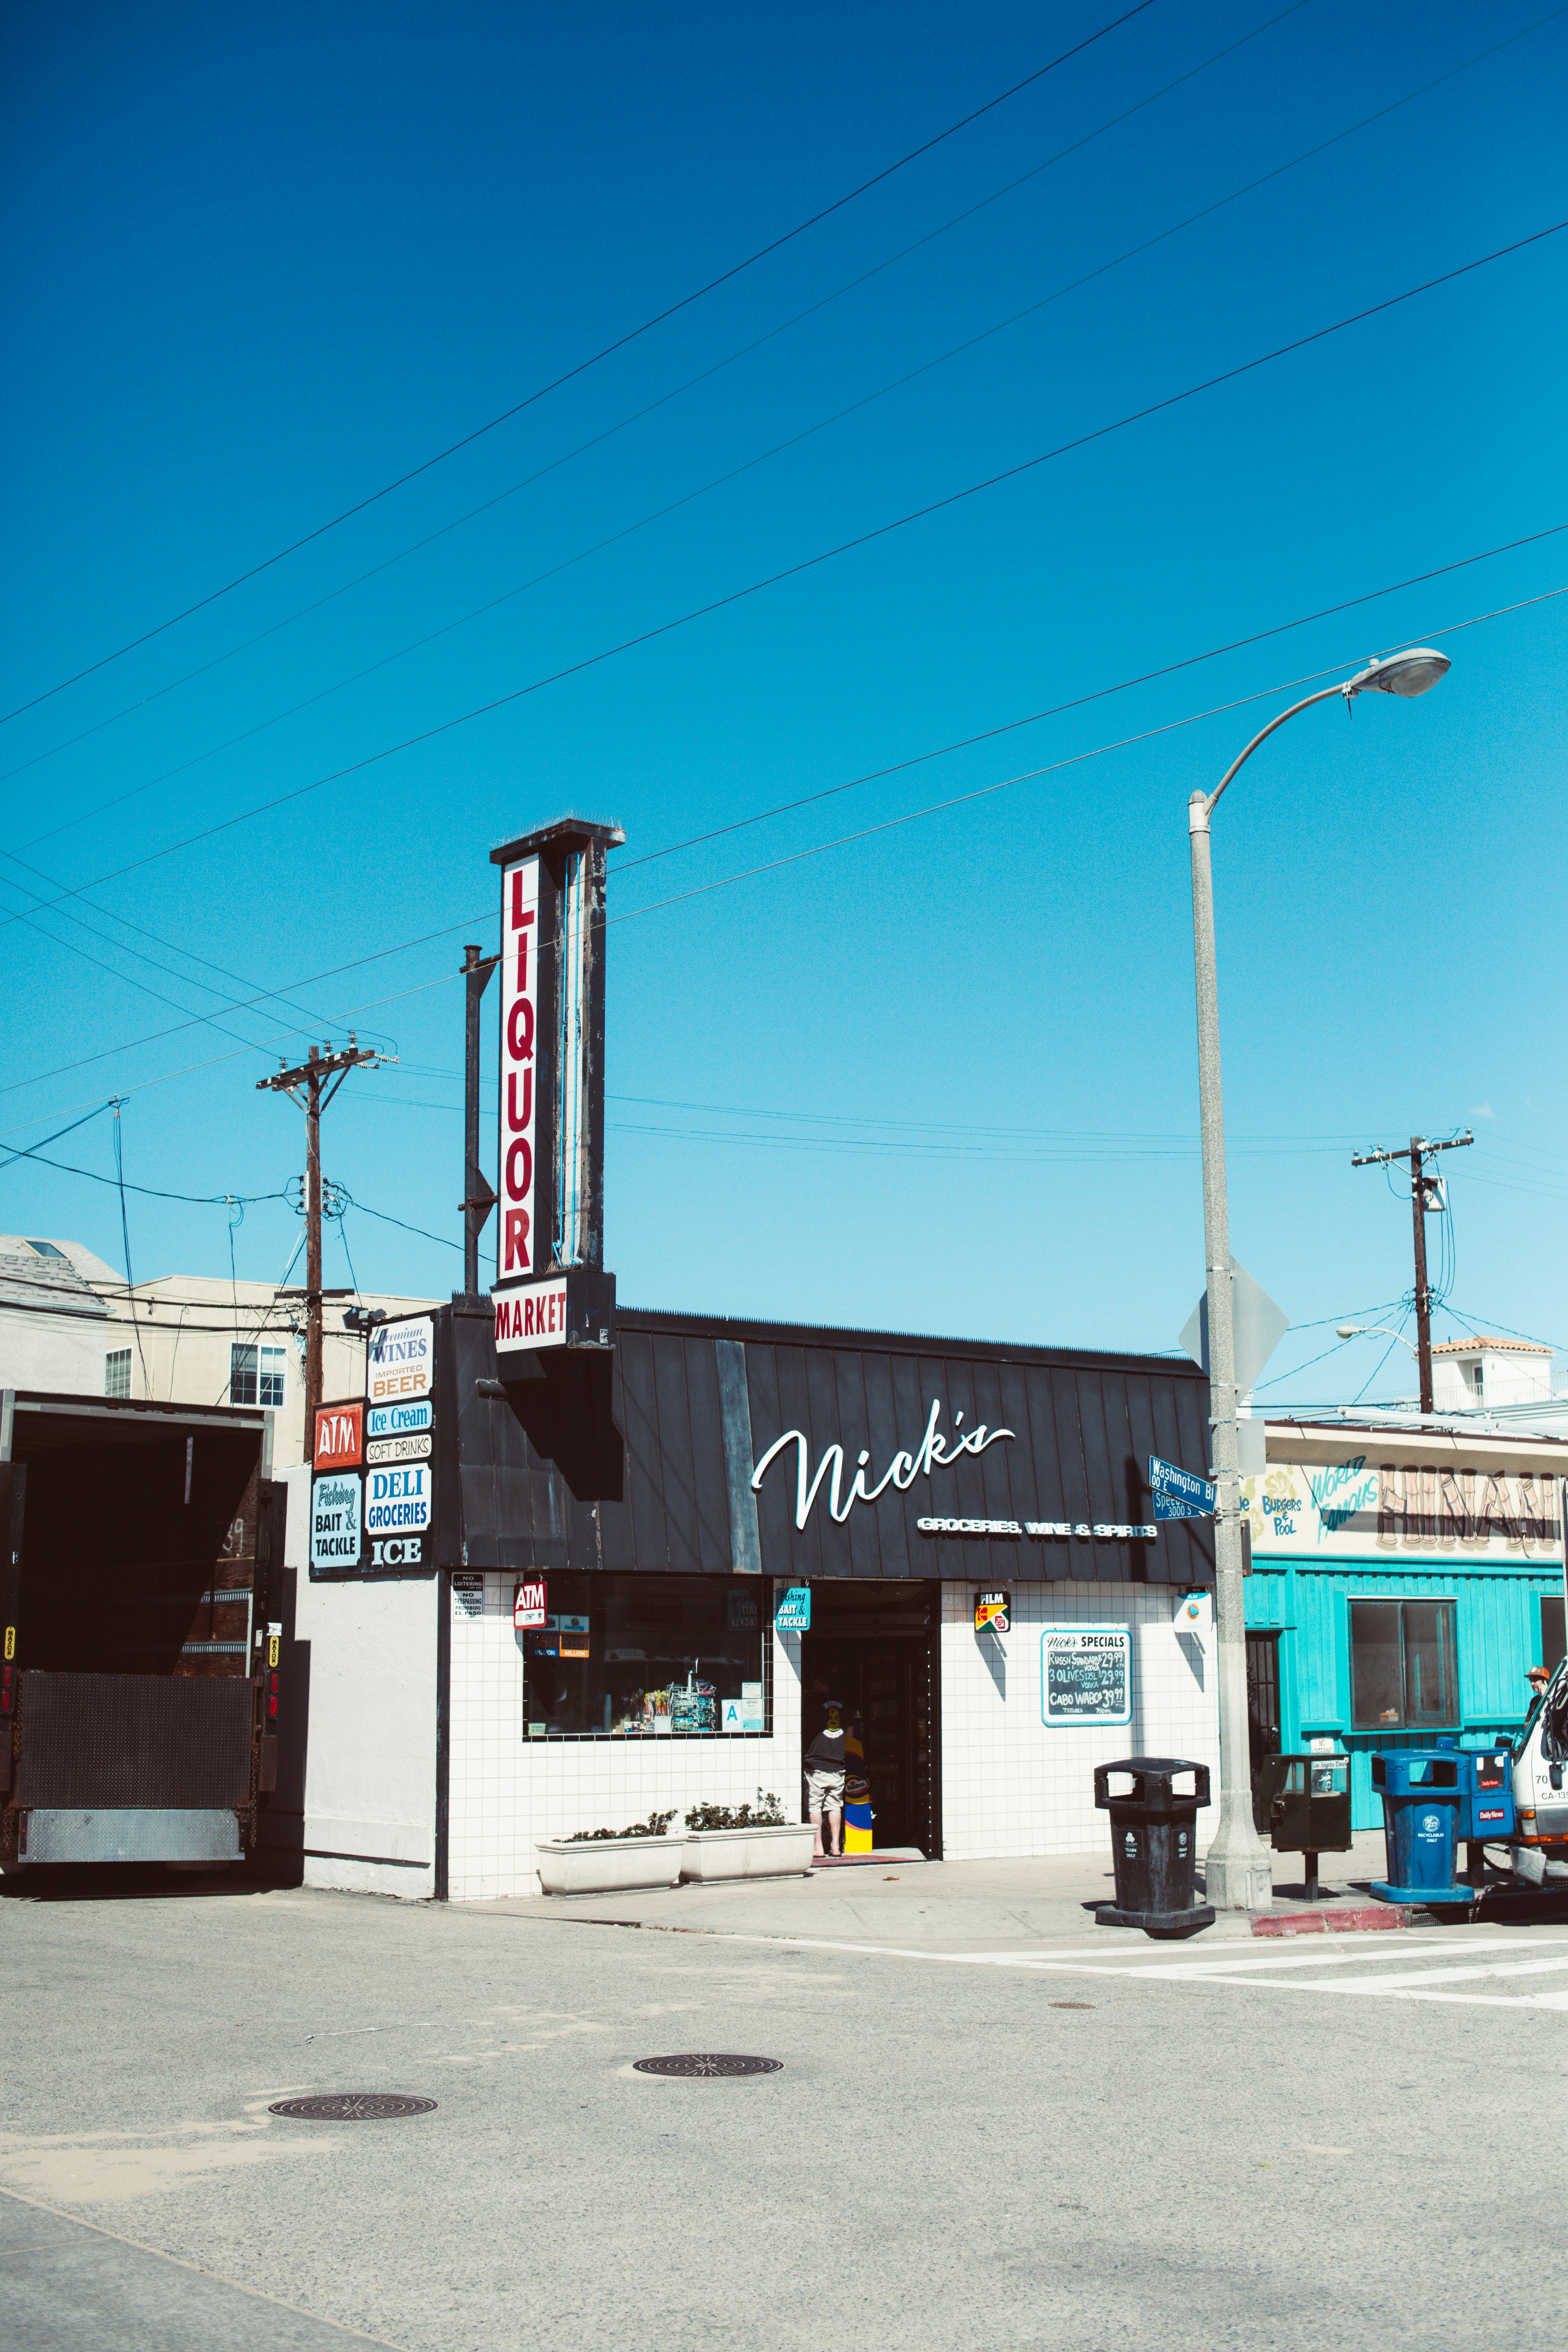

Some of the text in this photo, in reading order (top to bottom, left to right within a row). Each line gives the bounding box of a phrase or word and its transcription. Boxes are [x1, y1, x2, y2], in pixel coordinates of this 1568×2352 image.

[505, 870, 535, 1271] LIQUOR
[495, 1292, 566, 1340] MARKET
[373, 1327, 423, 1345] Premium
[373, 1338, 427, 1364] WINES
[376, 1365, 423, 1379] IMPORTED
[373, 1373, 427, 1397] BEER
[371, 1408, 428, 1432] Ice Cream
[319, 1415, 355, 1456] ATM
[370, 1438, 428, 1460] SOFT DRINKS
[751, 1399, 1015, 1530] Nick's
[373, 1469, 424, 1499] DELI
[1153, 1459, 1200, 1495] Washington
[1163, 1480, 1168, 1491] E
[1310, 1455, 1366, 1510] WORLD
[318, 1481, 355, 1513] Fishing
[1380, 1463, 1568, 1548] HINAN
[369, 1501, 426, 1528] GROCERIES
[1169, 1505, 1191, 1517] 3000 S
[1317, 1476, 1378, 1546] FAMOUS
[316, 1511, 357, 1533] BAIT &
[917, 1518, 1158, 1537] GROCERIES, WINE & SPIRITS
[1274, 1517, 1297, 1536] POOL
[316, 1536, 355, 1556] TACKLE
[371, 1537, 422, 1568] ICE
[515, 1584, 544, 1610] ATM
[780, 1591, 806, 1604] Fishing
[980, 1593, 1004, 1604] FILM
[778, 1605, 804, 1615] BAIT &
[778, 1617, 808, 1627] TACKLE
[1047, 1636, 1124, 1649] Nick's SPECIALS
[1049, 1669, 1055, 1682] 3
[1050, 1692, 1073, 1705] CABO
[1075, 1692, 1099, 1705] WABO
[727, 1705, 737, 1721] A
[847, 1782, 865, 1791] Hostess
[1535, 1775, 1548, 1784] 70
[1480, 1811, 1491, 1820] Daily
